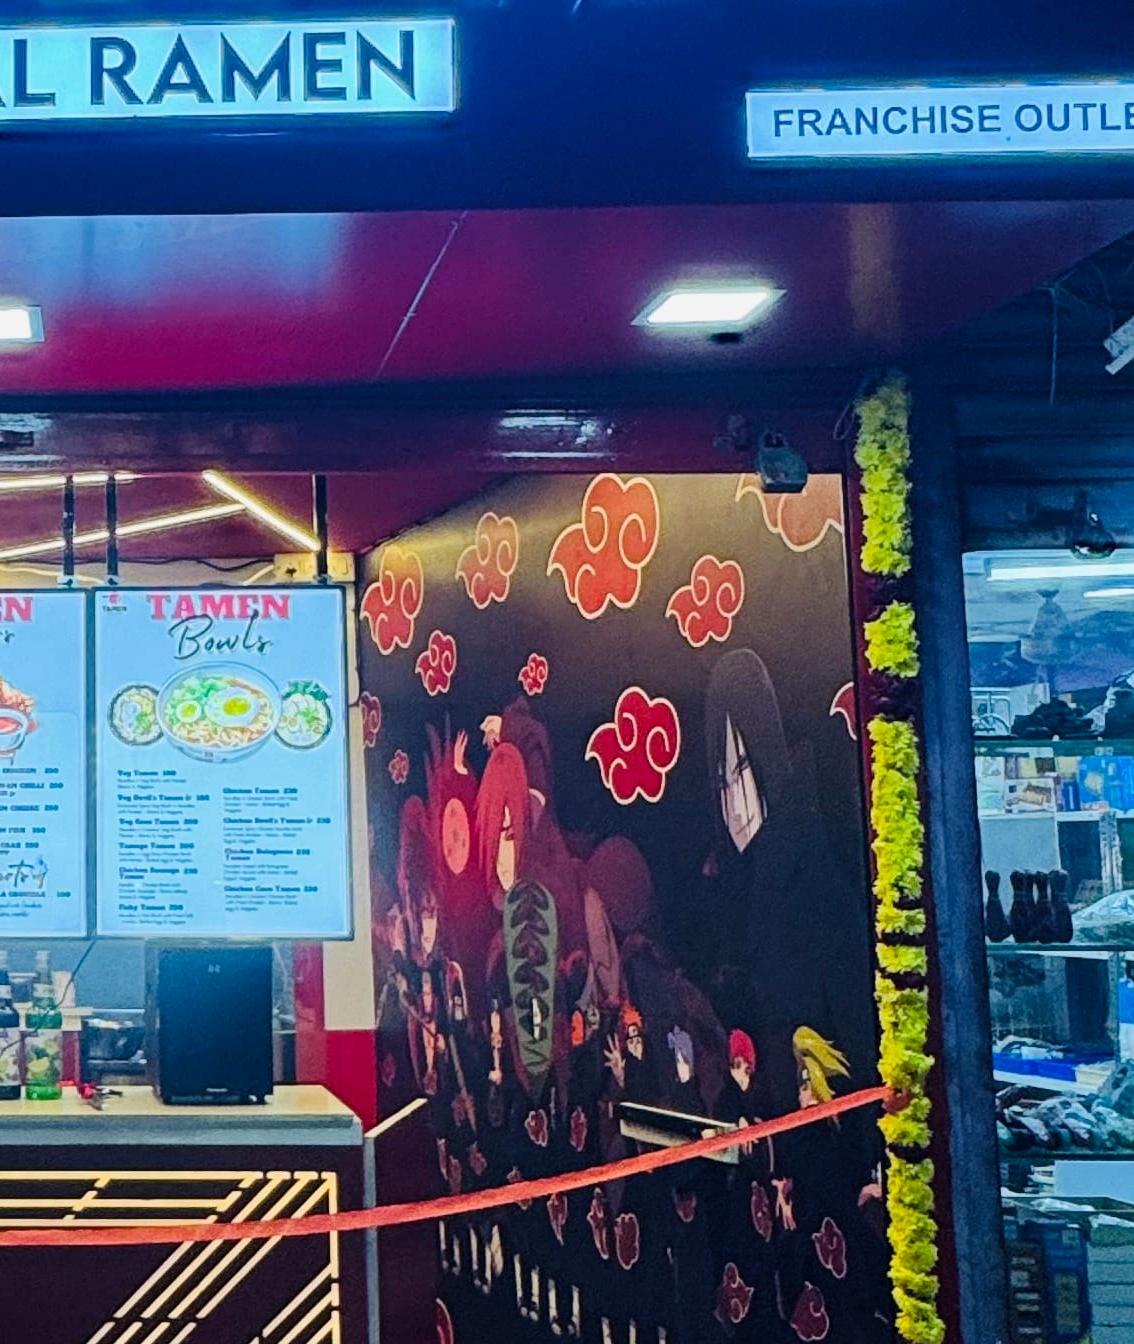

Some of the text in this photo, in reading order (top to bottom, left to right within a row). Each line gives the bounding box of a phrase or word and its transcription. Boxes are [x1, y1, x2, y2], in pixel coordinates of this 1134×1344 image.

[90, 30, 416, 105] RAMEN
[773, 104, 1002, 137] FRANCHISE
[147, 594, 290, 620] TAMEN
[168, 609, 274, 659] Bowls
